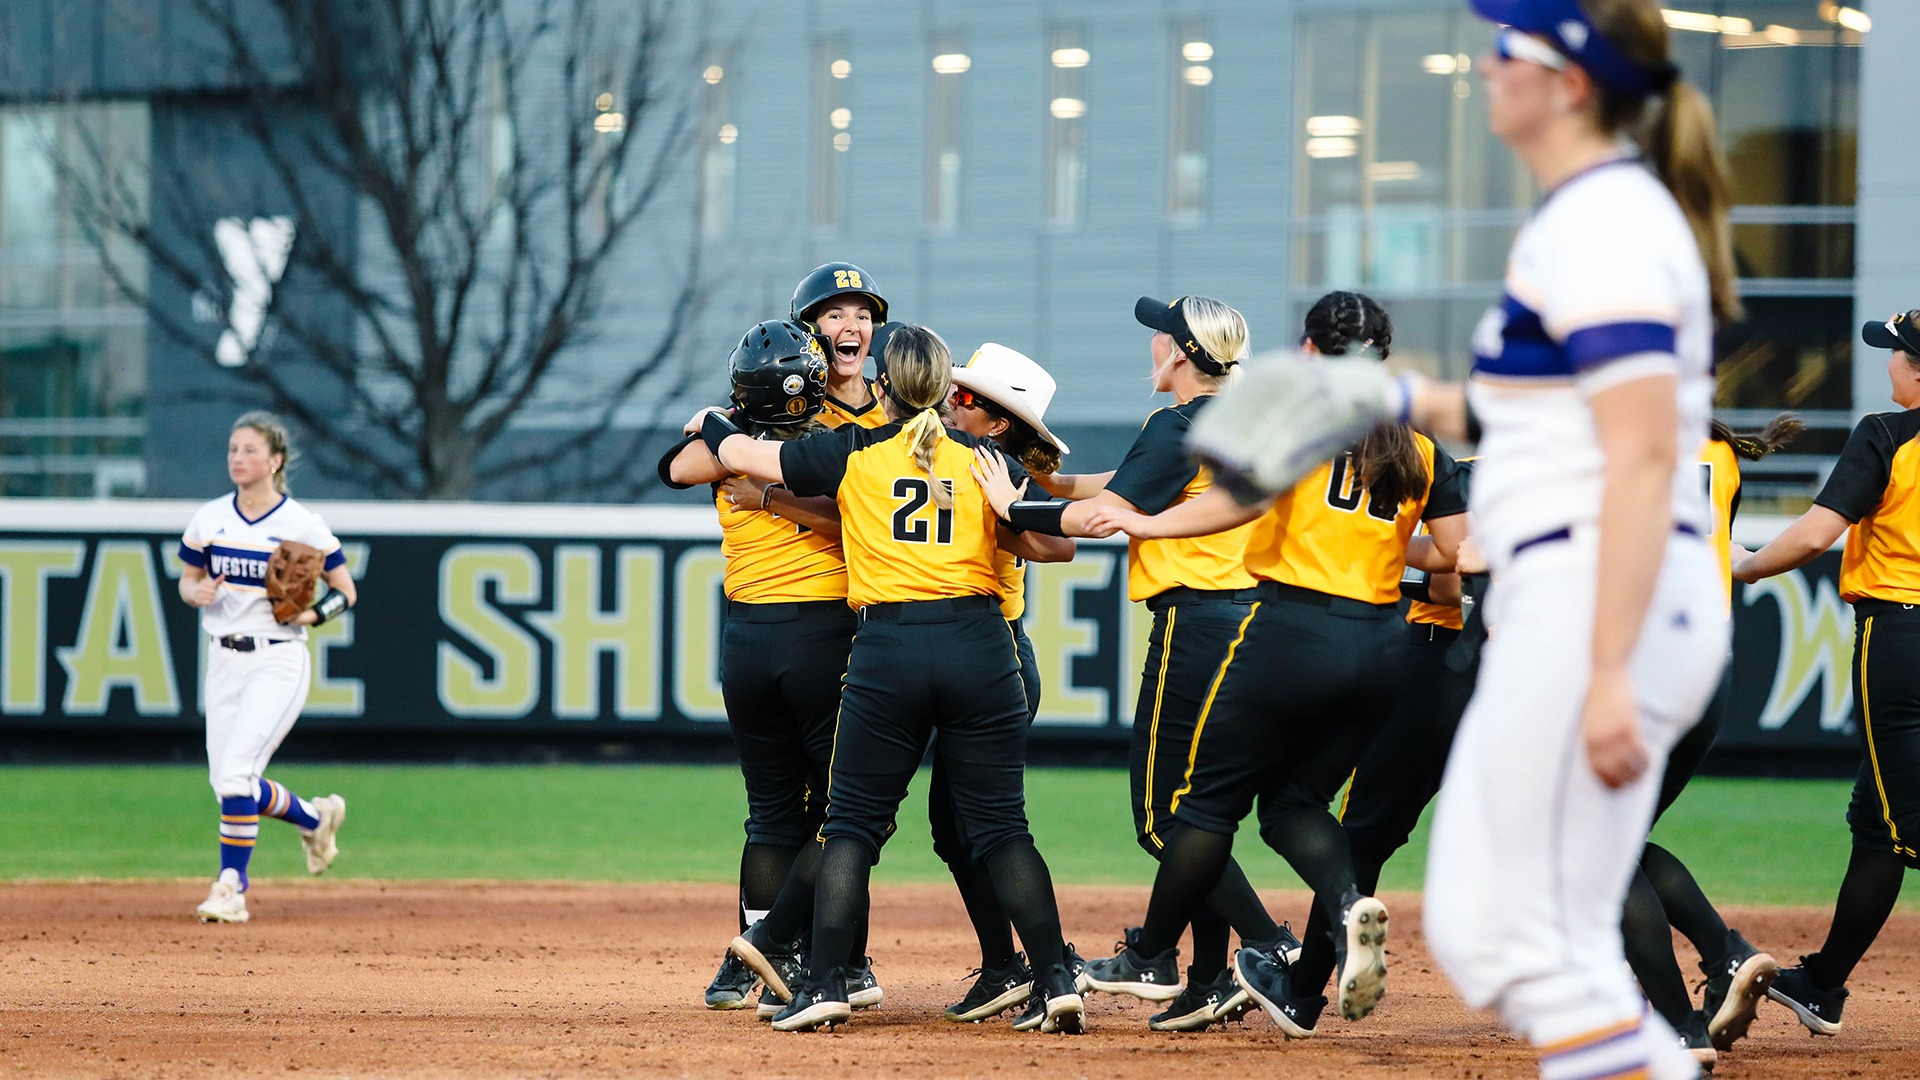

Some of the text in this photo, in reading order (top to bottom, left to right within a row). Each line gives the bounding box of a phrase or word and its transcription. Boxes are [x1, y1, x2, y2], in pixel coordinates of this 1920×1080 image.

[833, 270, 863, 289] 28
[891, 476, 954, 546] 21
[210, 553, 270, 580] WESTER
